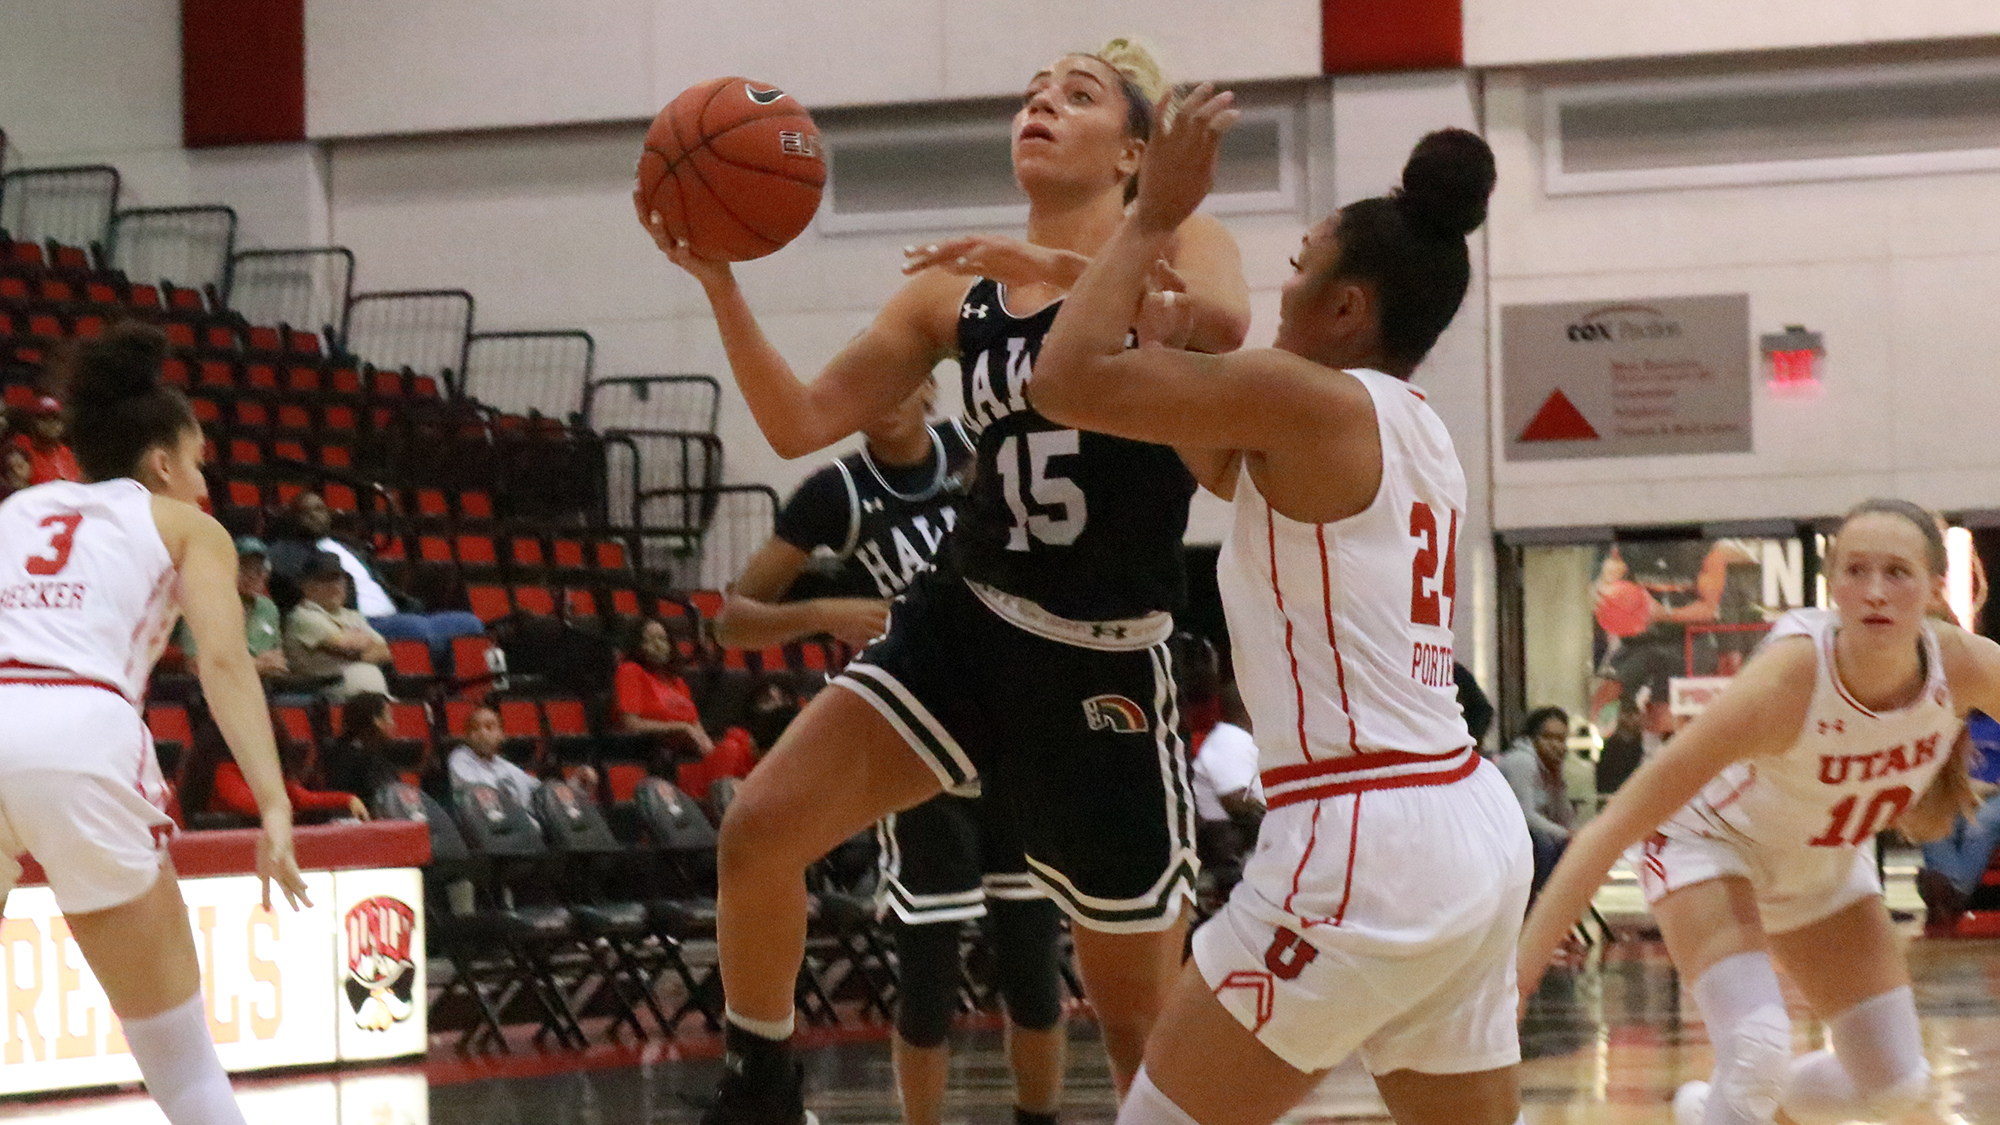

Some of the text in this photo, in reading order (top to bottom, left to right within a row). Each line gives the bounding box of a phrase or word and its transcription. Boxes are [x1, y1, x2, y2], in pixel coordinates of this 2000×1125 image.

[996, 429, 1088, 551] 15
[25, 510, 84, 576] 3
[1410, 501, 1457, 628] 24
[1817, 731, 1941, 785] UTAH
[1808, 784, 1915, 847] 10
[0, 903, 284, 1066] RELS
